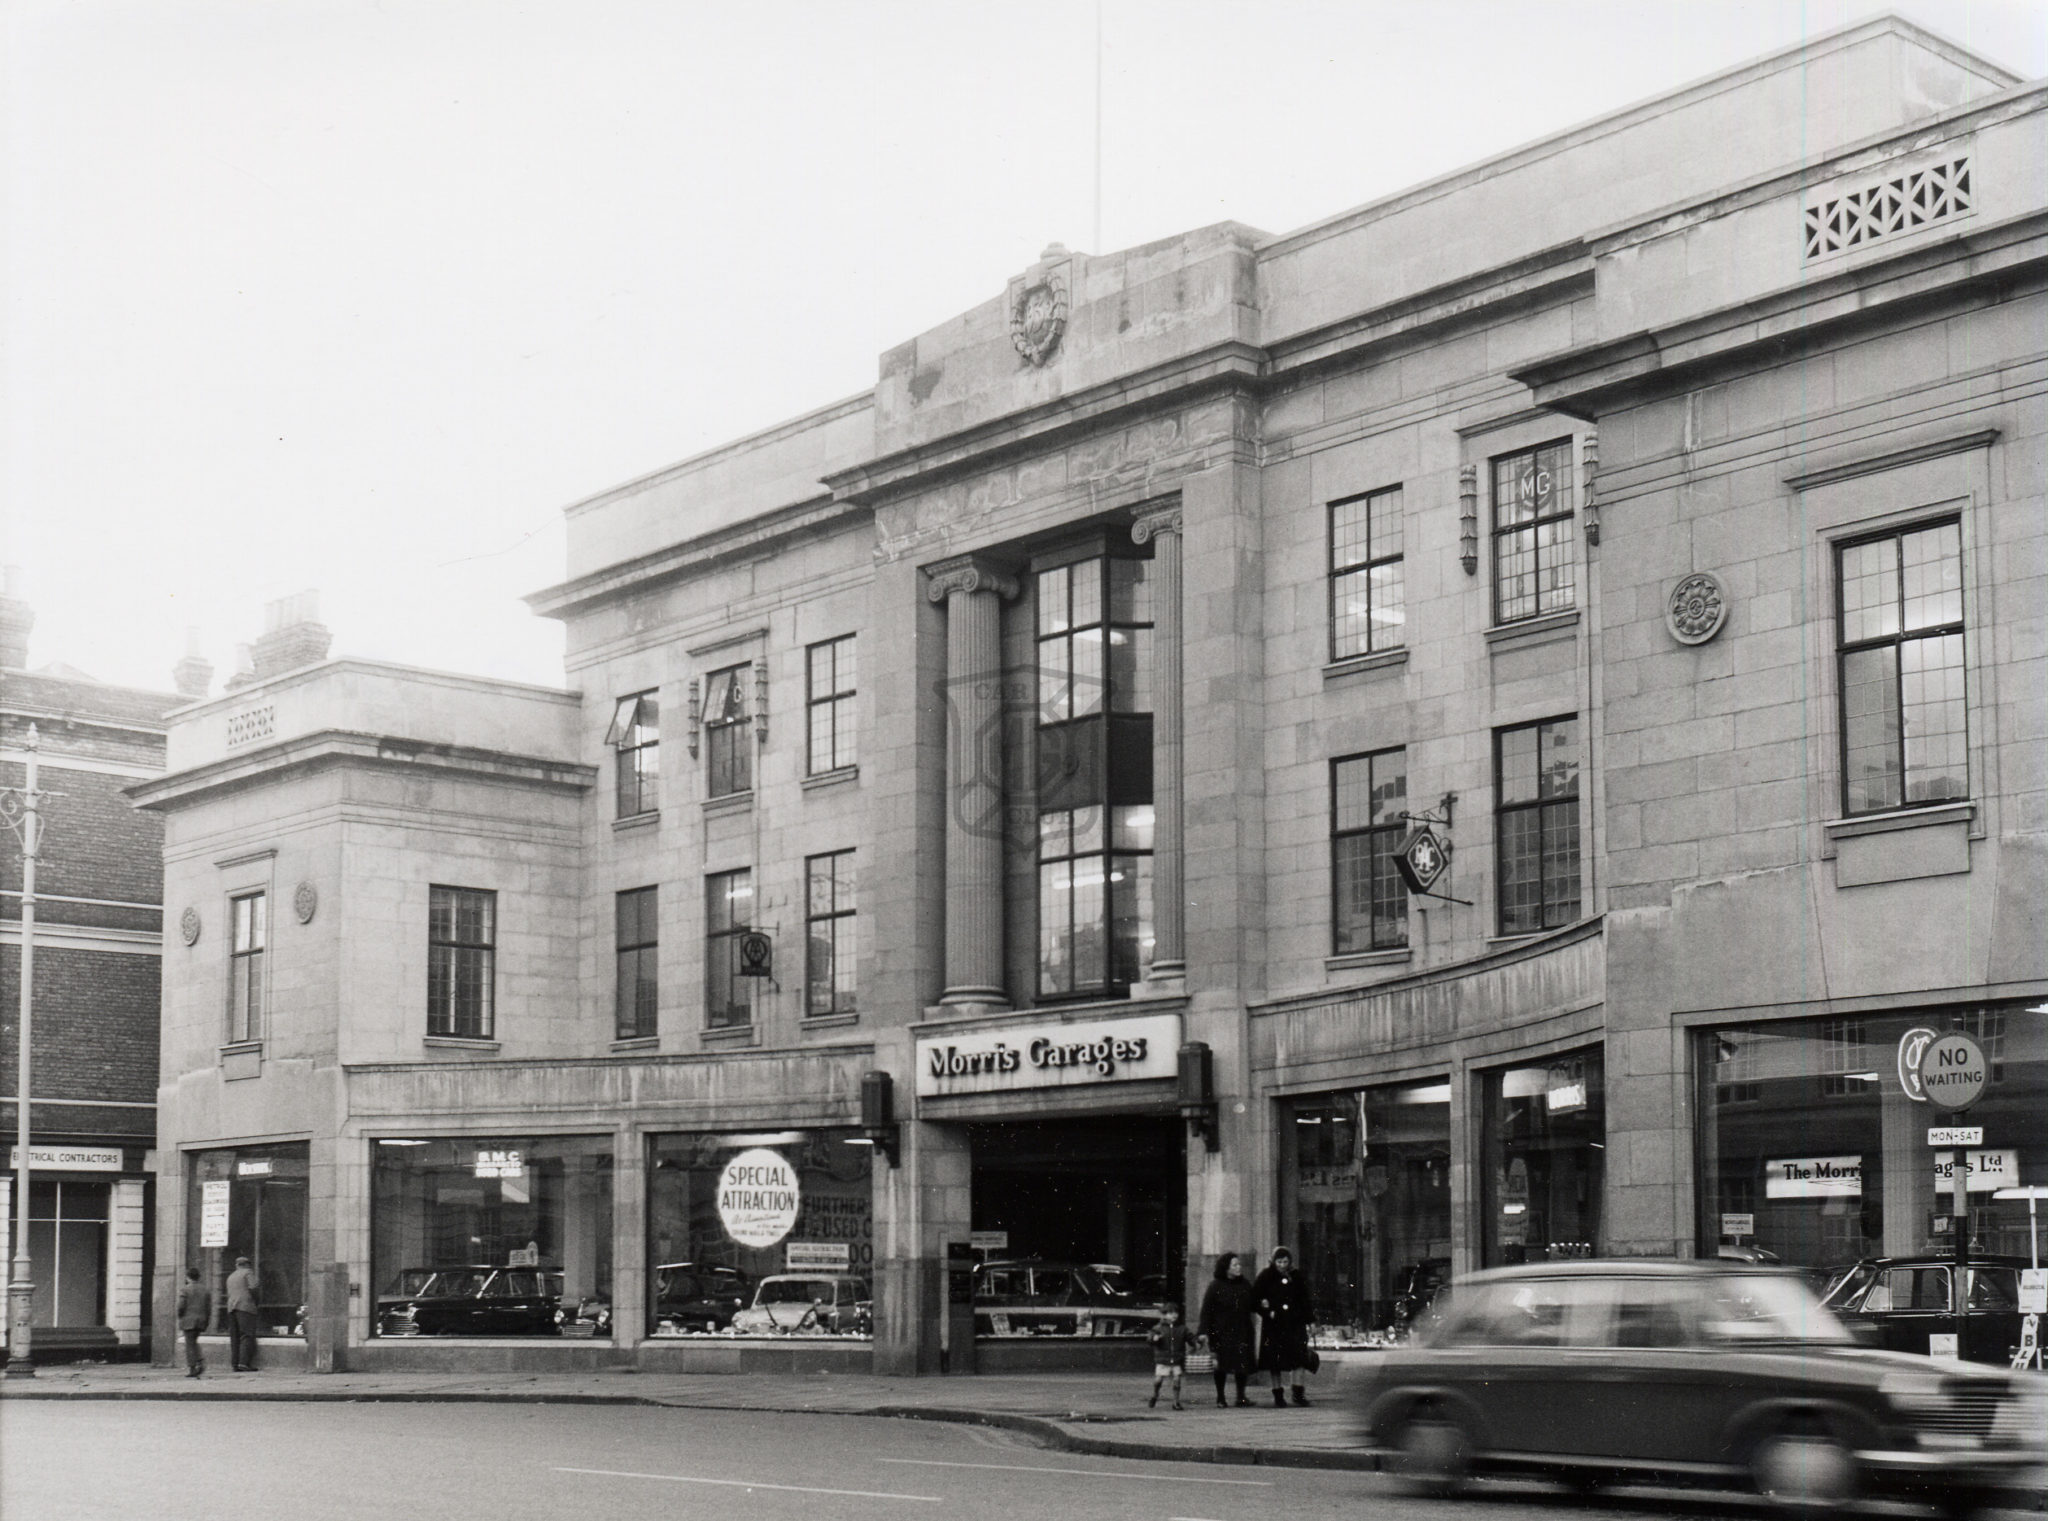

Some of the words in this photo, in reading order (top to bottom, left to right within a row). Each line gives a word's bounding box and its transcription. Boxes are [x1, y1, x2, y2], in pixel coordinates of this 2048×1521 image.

[1521, 471, 1551, 500] MG
[929, 1043, 1020, 1079] Morris
[1027, 1036, 1148, 1077] Garages
[1939, 1048, 1968, 1067] NO
[1925, 1071, 1983, 1087] WAITING
[1930, 1131, 1980, 1141] MON-SAT
[13, 1152, 55, 1162] ETRICAL
[59, 1153, 118, 1164] CONTRACTORS
[728, 1166, 789, 1186] SPECIAL
[1783, 1163, 1811, 1180] The
[1815, 1161, 1862, 1179] Morri
[721, 1190, 796, 1212] ATTRACTION
[823, 1216, 858, 1238] USED
